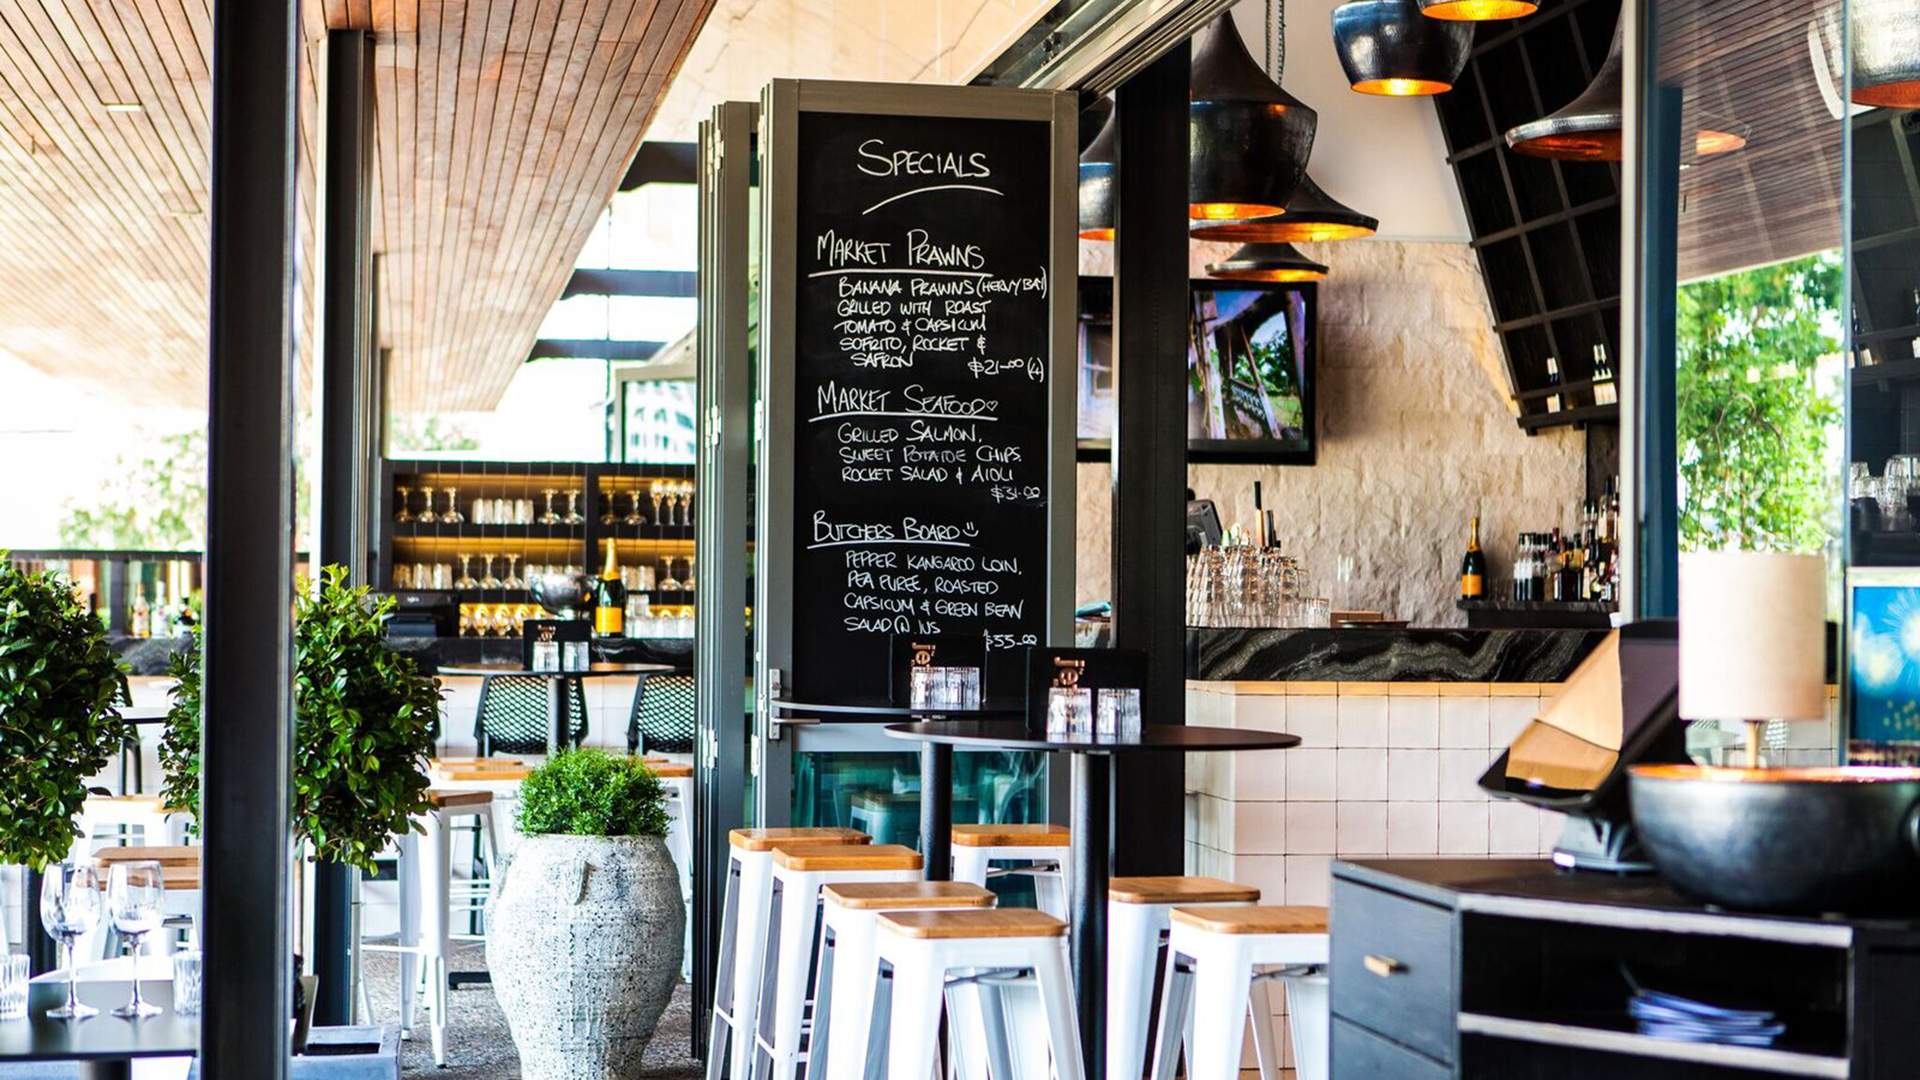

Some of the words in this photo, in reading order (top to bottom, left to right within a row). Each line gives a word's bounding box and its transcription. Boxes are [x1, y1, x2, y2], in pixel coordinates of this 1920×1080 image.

[857, 139, 990, 177] SPECIALS
[817, 229, 891, 267] MARKET
[905, 229, 984, 270] PRAWNS
[839, 276, 902, 297] BANANA
[911, 278, 975, 296] PRAWNS
[837, 299, 891, 317] GRILLED
[900, 300, 932, 316] WITH
[945, 300, 992, 316] ROAST
[833, 319, 896, 334] TOMATO
[913, 313, 986, 335] CAPSICUM
[840, 336, 906, 354] SOFRITO,
[911, 334, 969, 353] ROCKET
[850, 351, 913, 369] SAFRON
[818, 380, 892, 413] MARKET
[903, 384, 987, 415] SEAFOOD
[838, 422, 898, 443] GRILLED
[839, 447, 893, 464] SWEET
[903, 445, 966, 463] POTATOE
[842, 466, 893, 482] ROCKET
[900, 466, 948, 482] SALAD
[971, 465, 1013, 482] AIOLI
[813, 510, 895, 541] BUTCHERS
[903, 517, 960, 540] BOARD
[846, 550, 897, 568] PEPPER
[907, 555, 975, 572] KANGAROO
[848, 570, 874, 589] PEA
[935, 577, 998, 594] ROASTED
[844, 593, 915, 615] CAPSICUM
[935, 599, 977, 617] GREEN
[985, 600, 1023, 619] BEAN
[844, 617, 892, 632] SALAD
